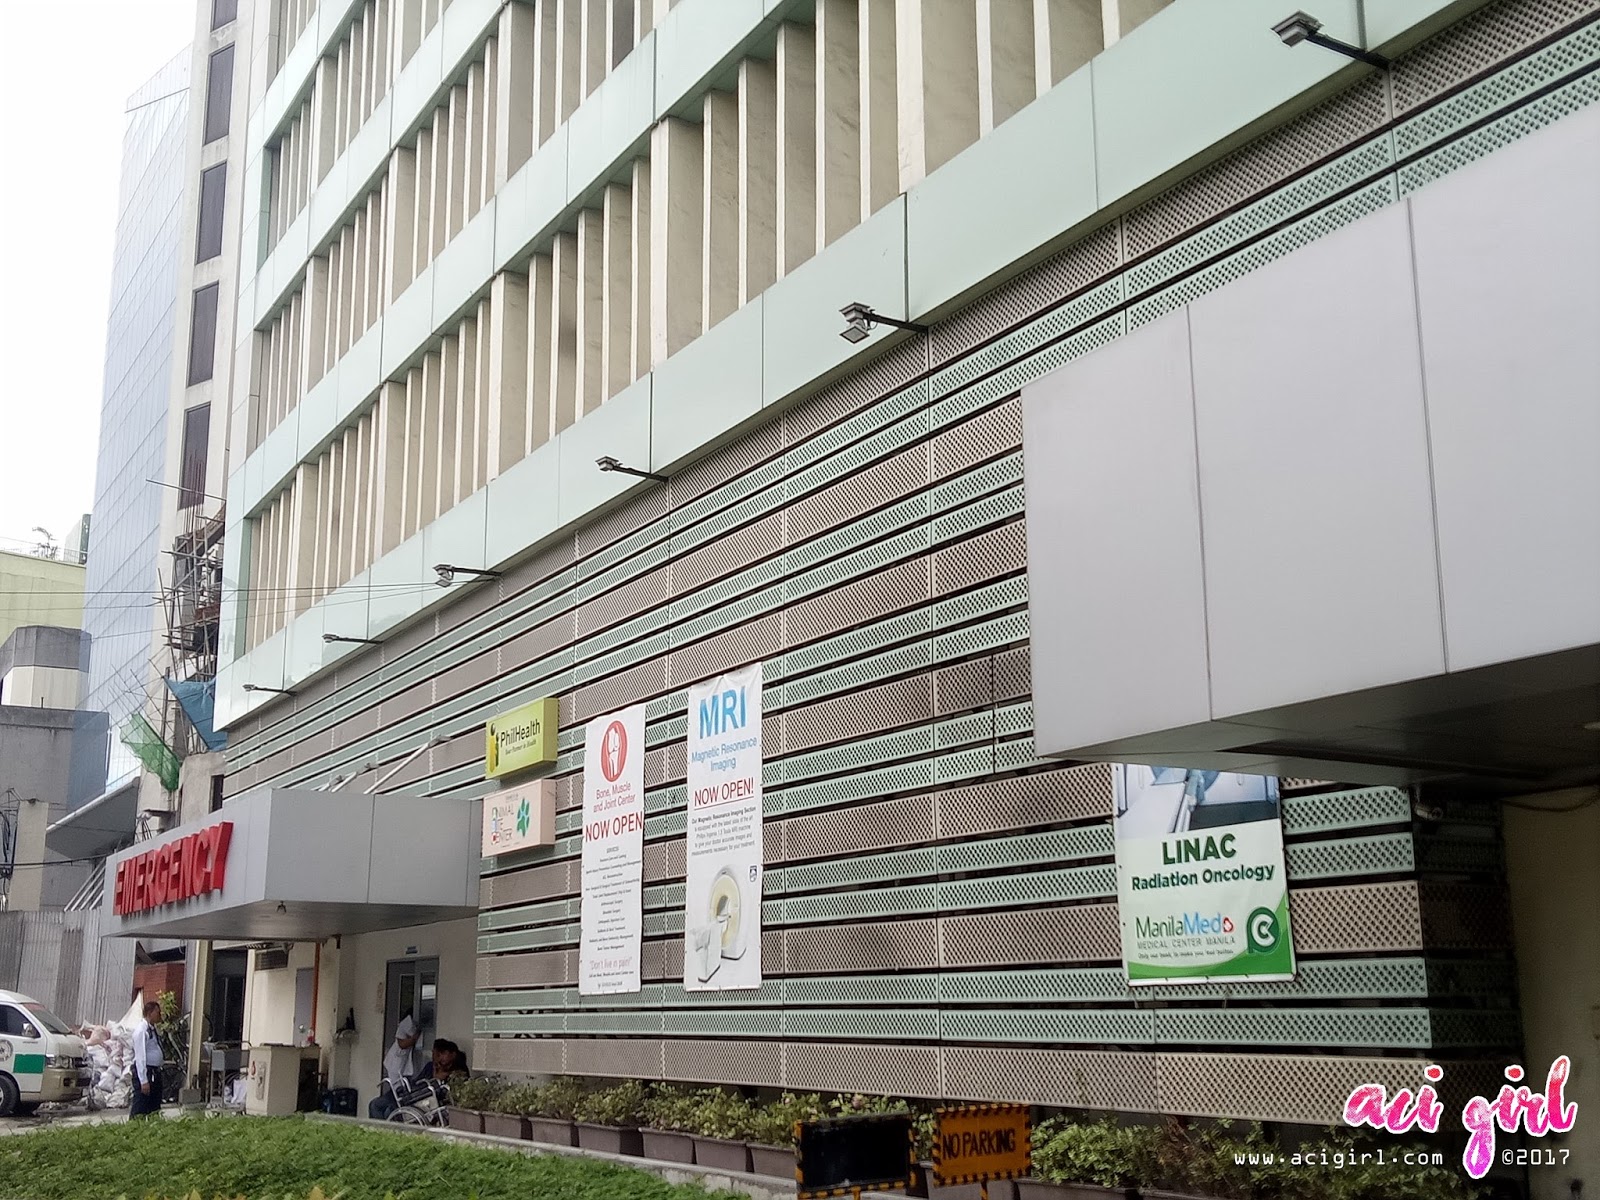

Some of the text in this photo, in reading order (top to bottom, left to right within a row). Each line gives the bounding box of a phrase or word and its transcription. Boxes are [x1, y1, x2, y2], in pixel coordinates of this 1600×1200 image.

[700, 686, 746, 739] MRI
[501, 718, 541, 748] PhilHealth
[691, 737, 757, 763] Magnetic Resonance
[710, 757, 737, 772] Imaging
[593, 794, 636, 812] and Joint Center
[596, 781, 631, 800] Bone, Muscle
[694, 777, 754, 807] NOW OPEN!
[585, 811, 643, 842] NOW OPEN
[1162, 833, 1237, 865] LINAC
[113, 821, 234, 916] EMERGENCY
[1131, 864, 1275, 890] Radiation Oncology
[1135, 911, 1221, 939] ManilaMed
[1137, 937, 1236, 950] MEDICAL CENTER MANILA
[942, 1128, 1016, 1160] NO PARKING
